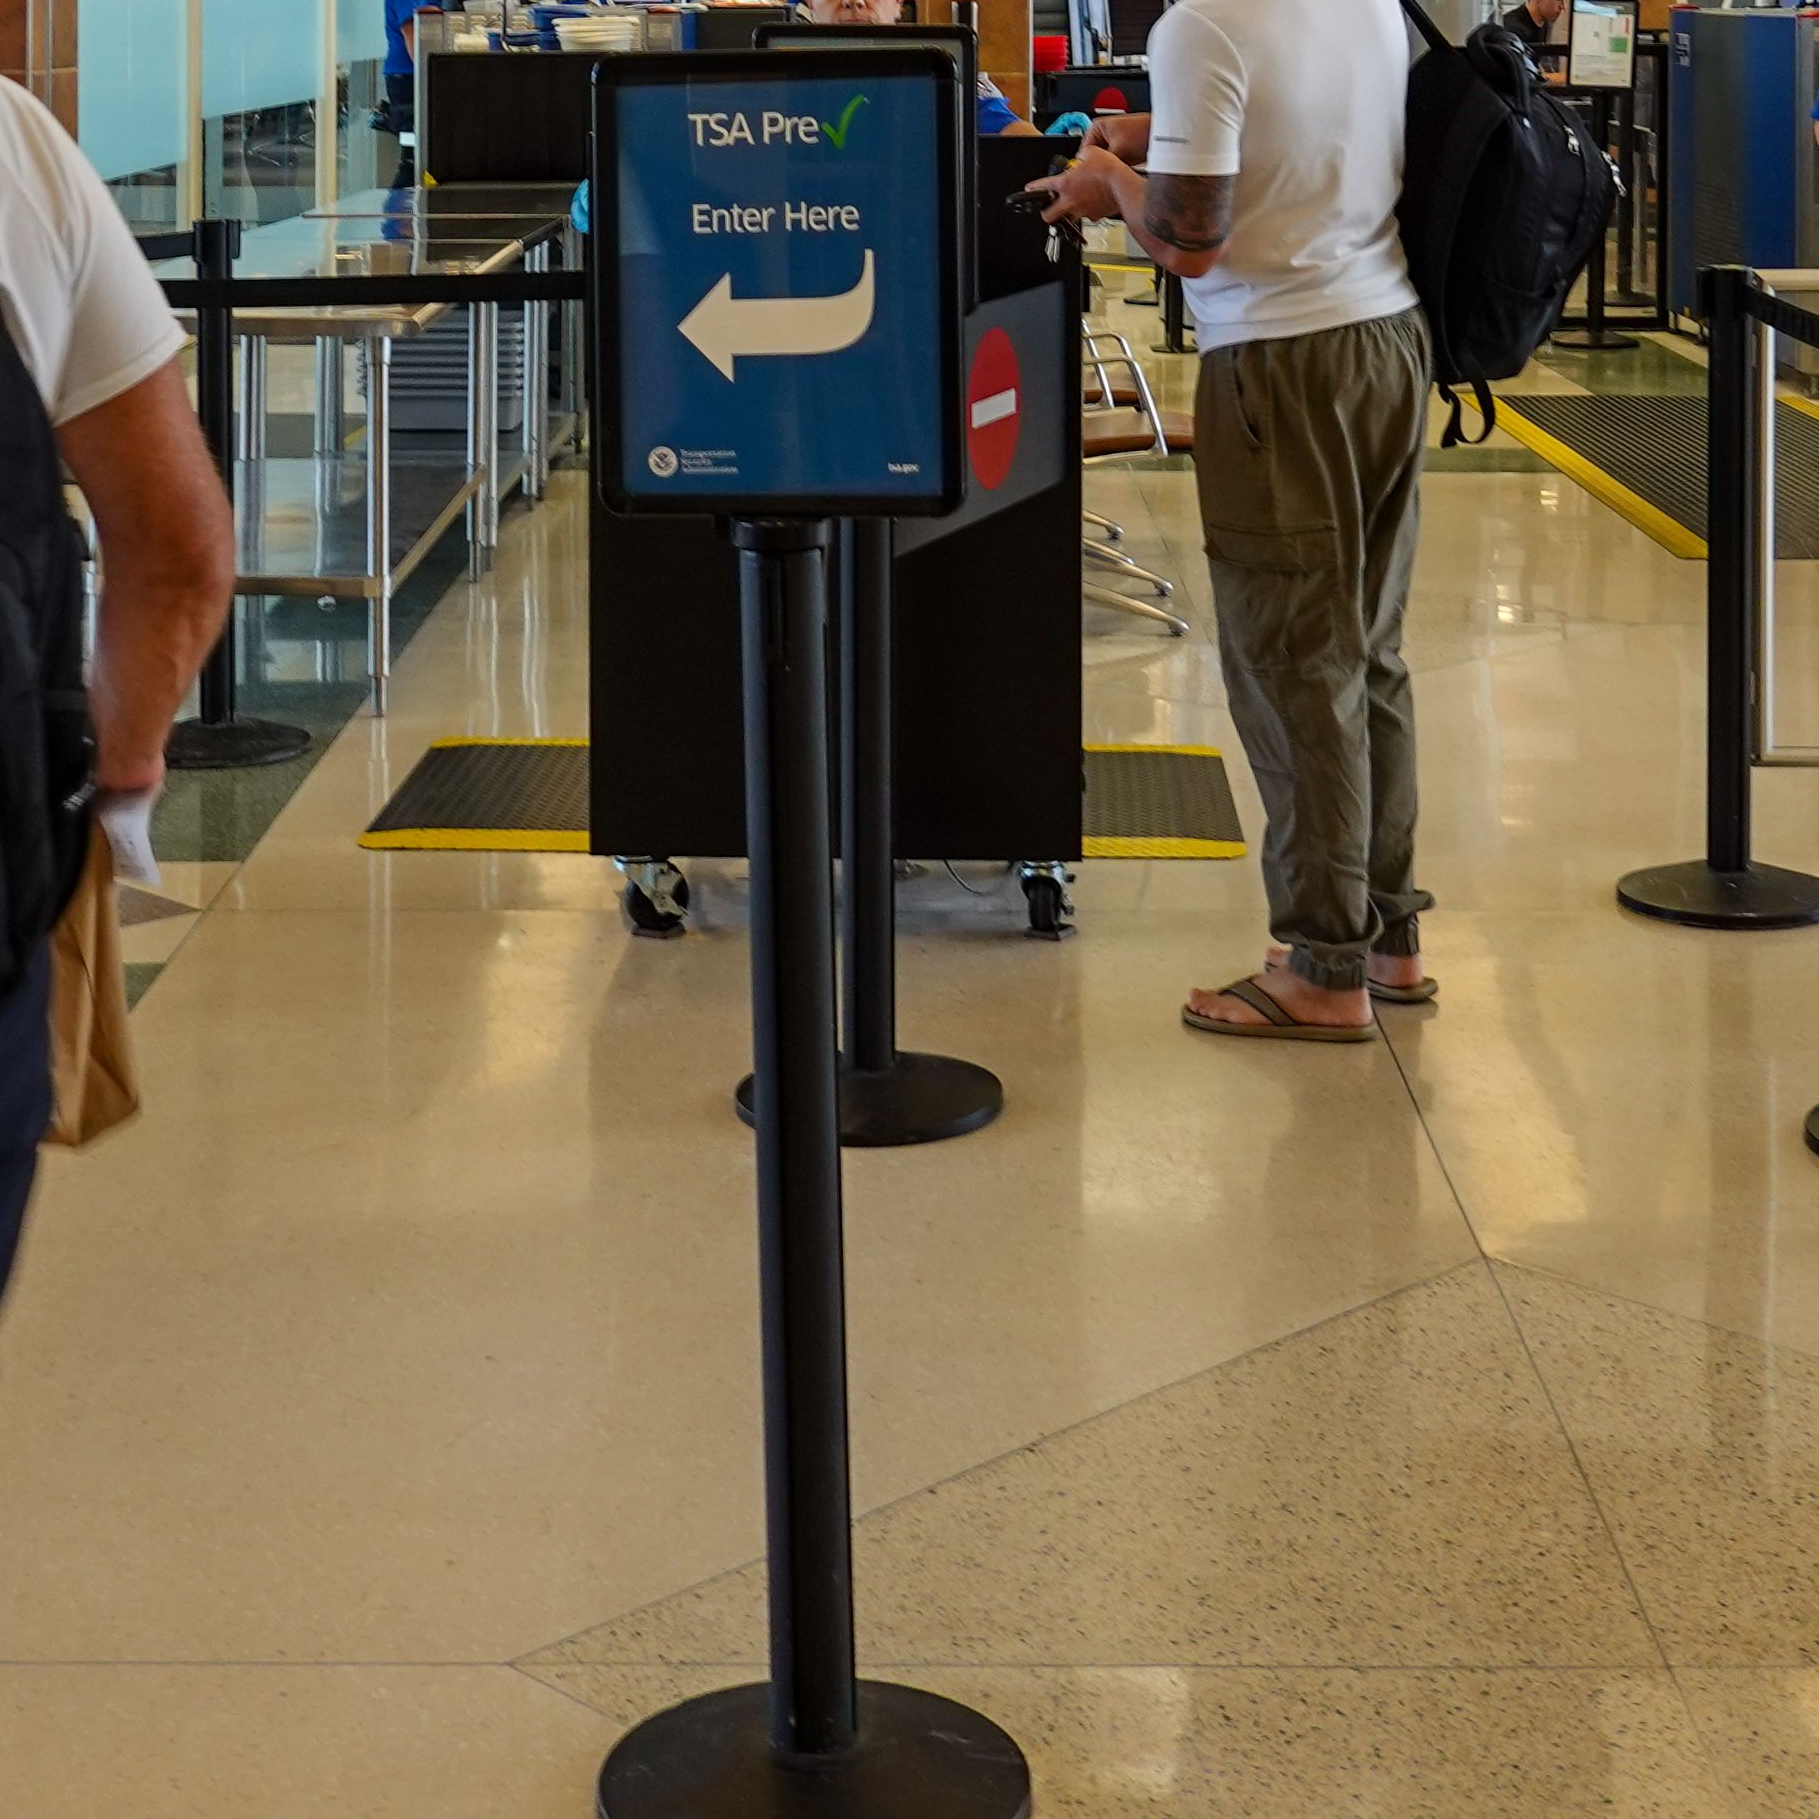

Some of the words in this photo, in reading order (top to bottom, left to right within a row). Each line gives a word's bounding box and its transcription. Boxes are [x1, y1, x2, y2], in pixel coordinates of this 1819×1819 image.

[688, 112, 755, 146] TSA
[763, 111, 820, 145] Pre
[692, 202, 775, 235] Enter
[785, 201, 860, 232] Here
